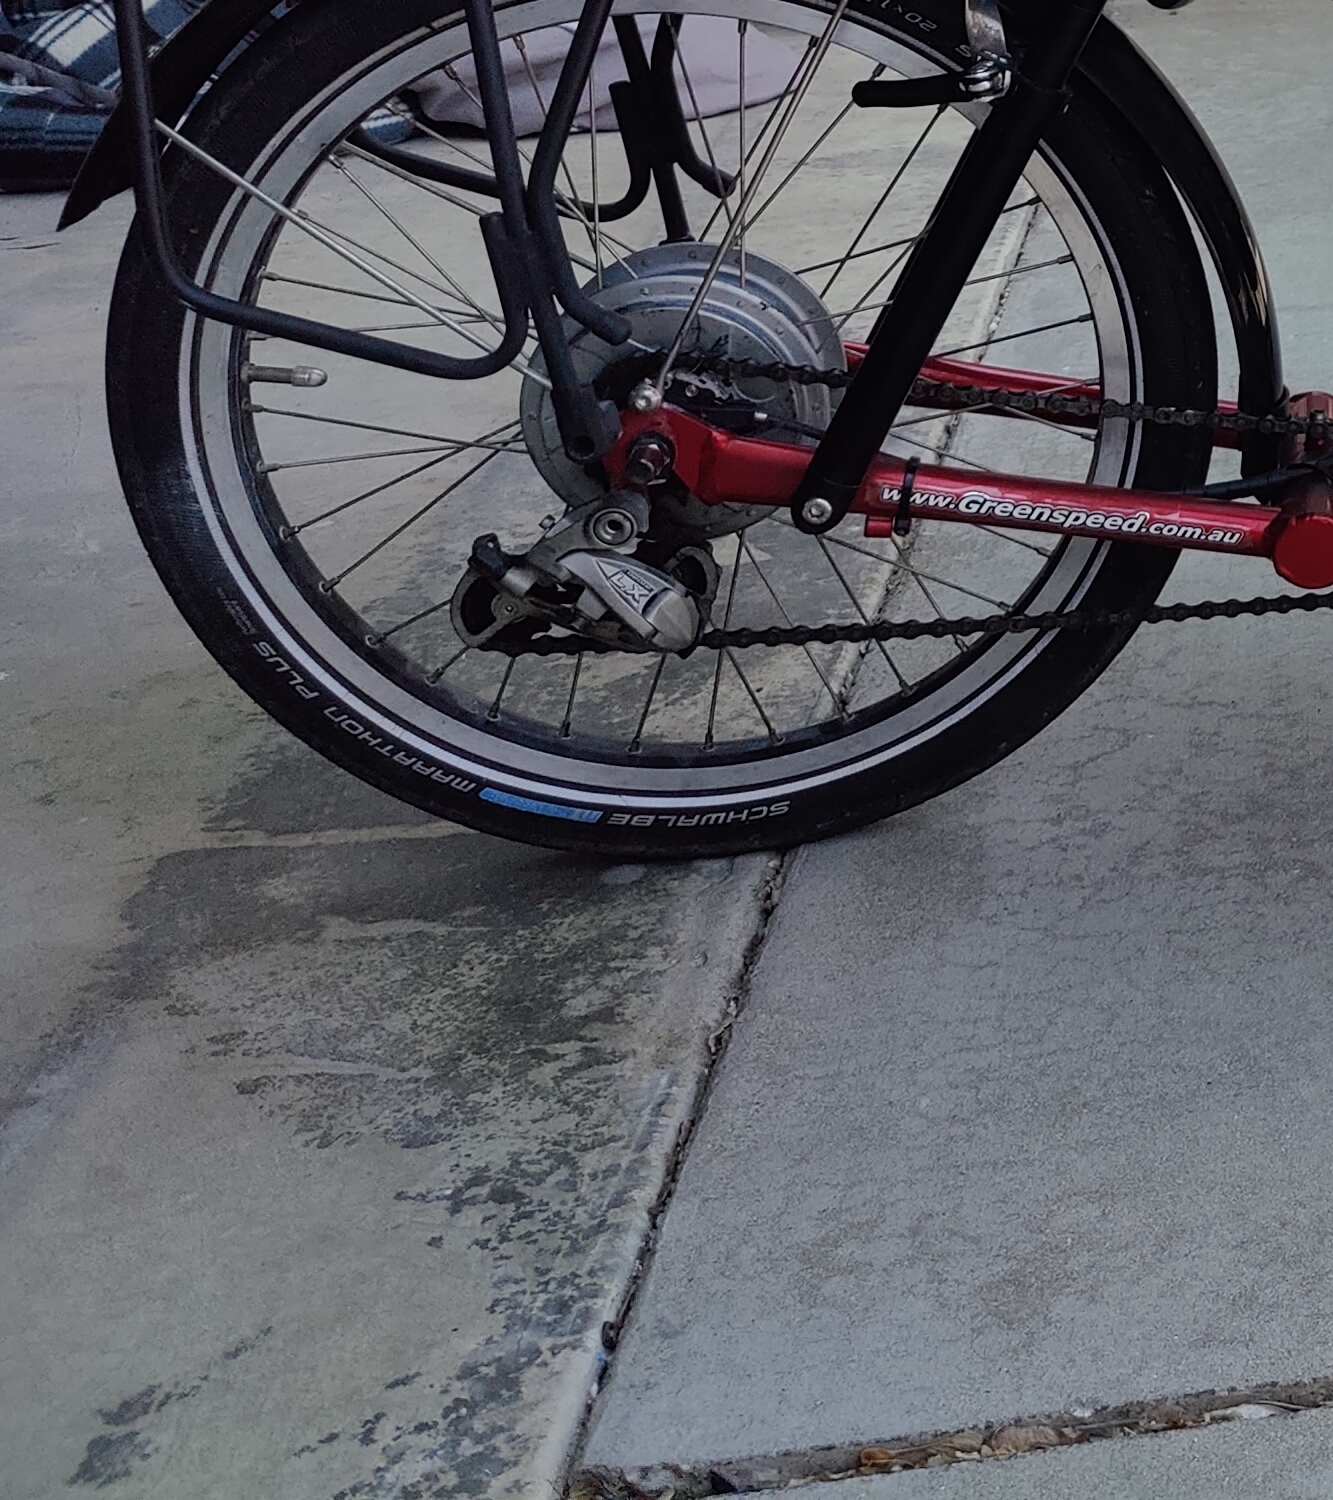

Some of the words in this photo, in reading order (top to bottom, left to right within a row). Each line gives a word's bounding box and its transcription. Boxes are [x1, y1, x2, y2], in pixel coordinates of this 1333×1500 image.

[881, 484, 1245, 545] www.Greenspeed.com.au
[610, 571, 650, 606] LX
[250, 641, 320, 699] PLUS
[324, 704, 477, 793] MARATHON
[607, 800, 791, 827] SCHWALBE
